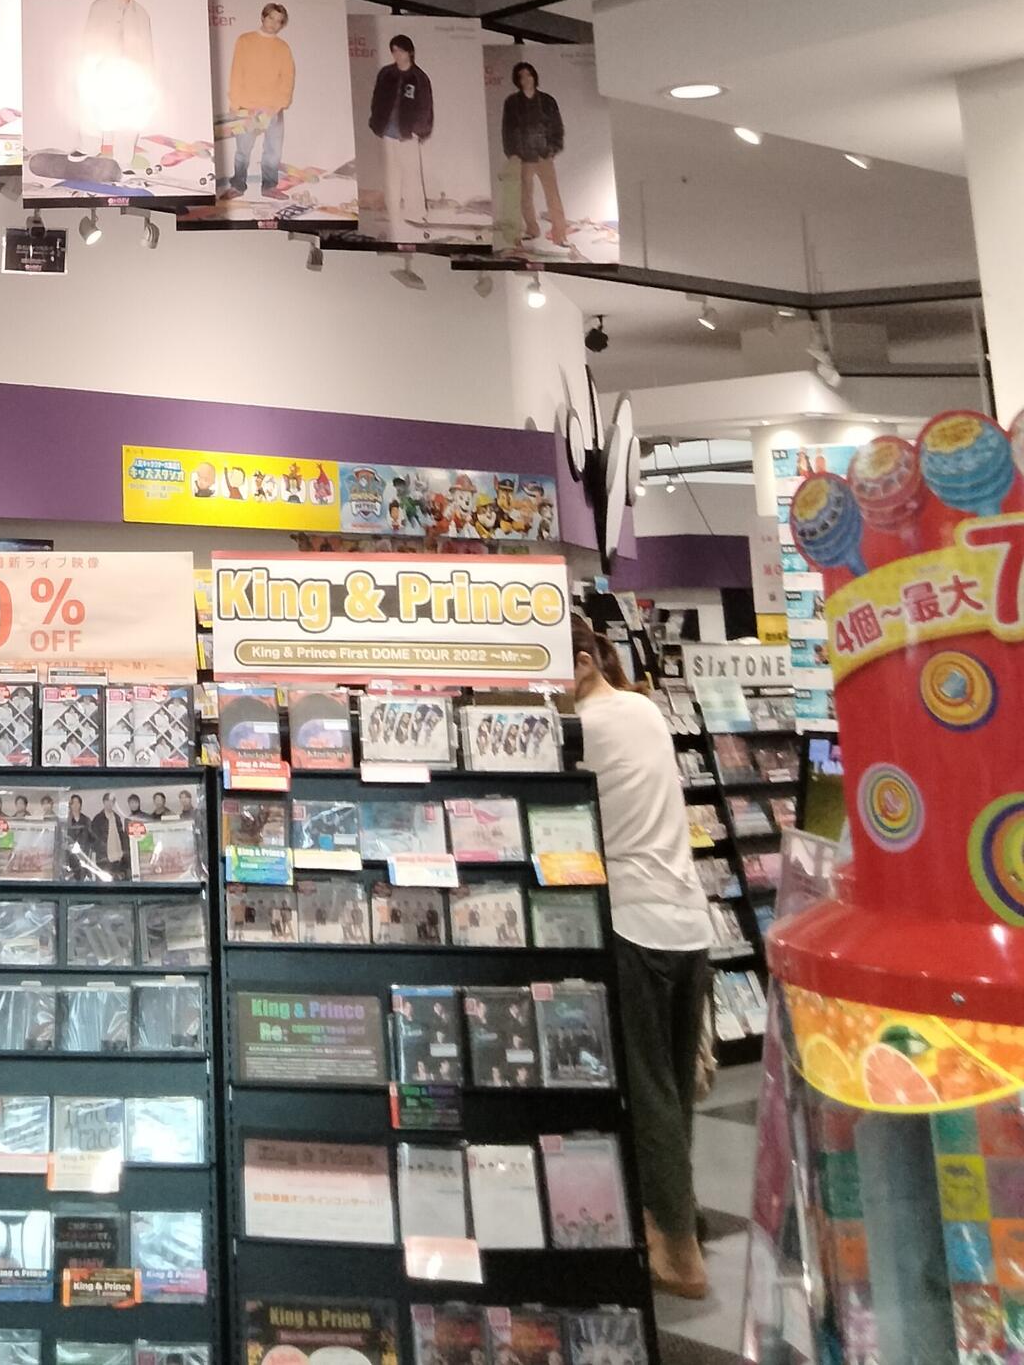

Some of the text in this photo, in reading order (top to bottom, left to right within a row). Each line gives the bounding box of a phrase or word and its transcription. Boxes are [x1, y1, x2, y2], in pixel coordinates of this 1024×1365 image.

[209, 15, 236, 27] ter
[217, 568, 565, 633] King & Prince
[30, 630, 82, 652] OFF
[251, 646, 280, 660] King
[283, 646, 294, 659] &
[297, 646, 337, 660] Prince
[340, 647, 369, 660] First
[372, 648, 410, 661] DOME
[412, 649, 449, 661] TOUR
[453, 649, 487, 662] 2022
[693, 655, 786, 677] SixTONE
[73, 1282, 93, 1292] King
[104, 1282, 131, 1292] Prince
